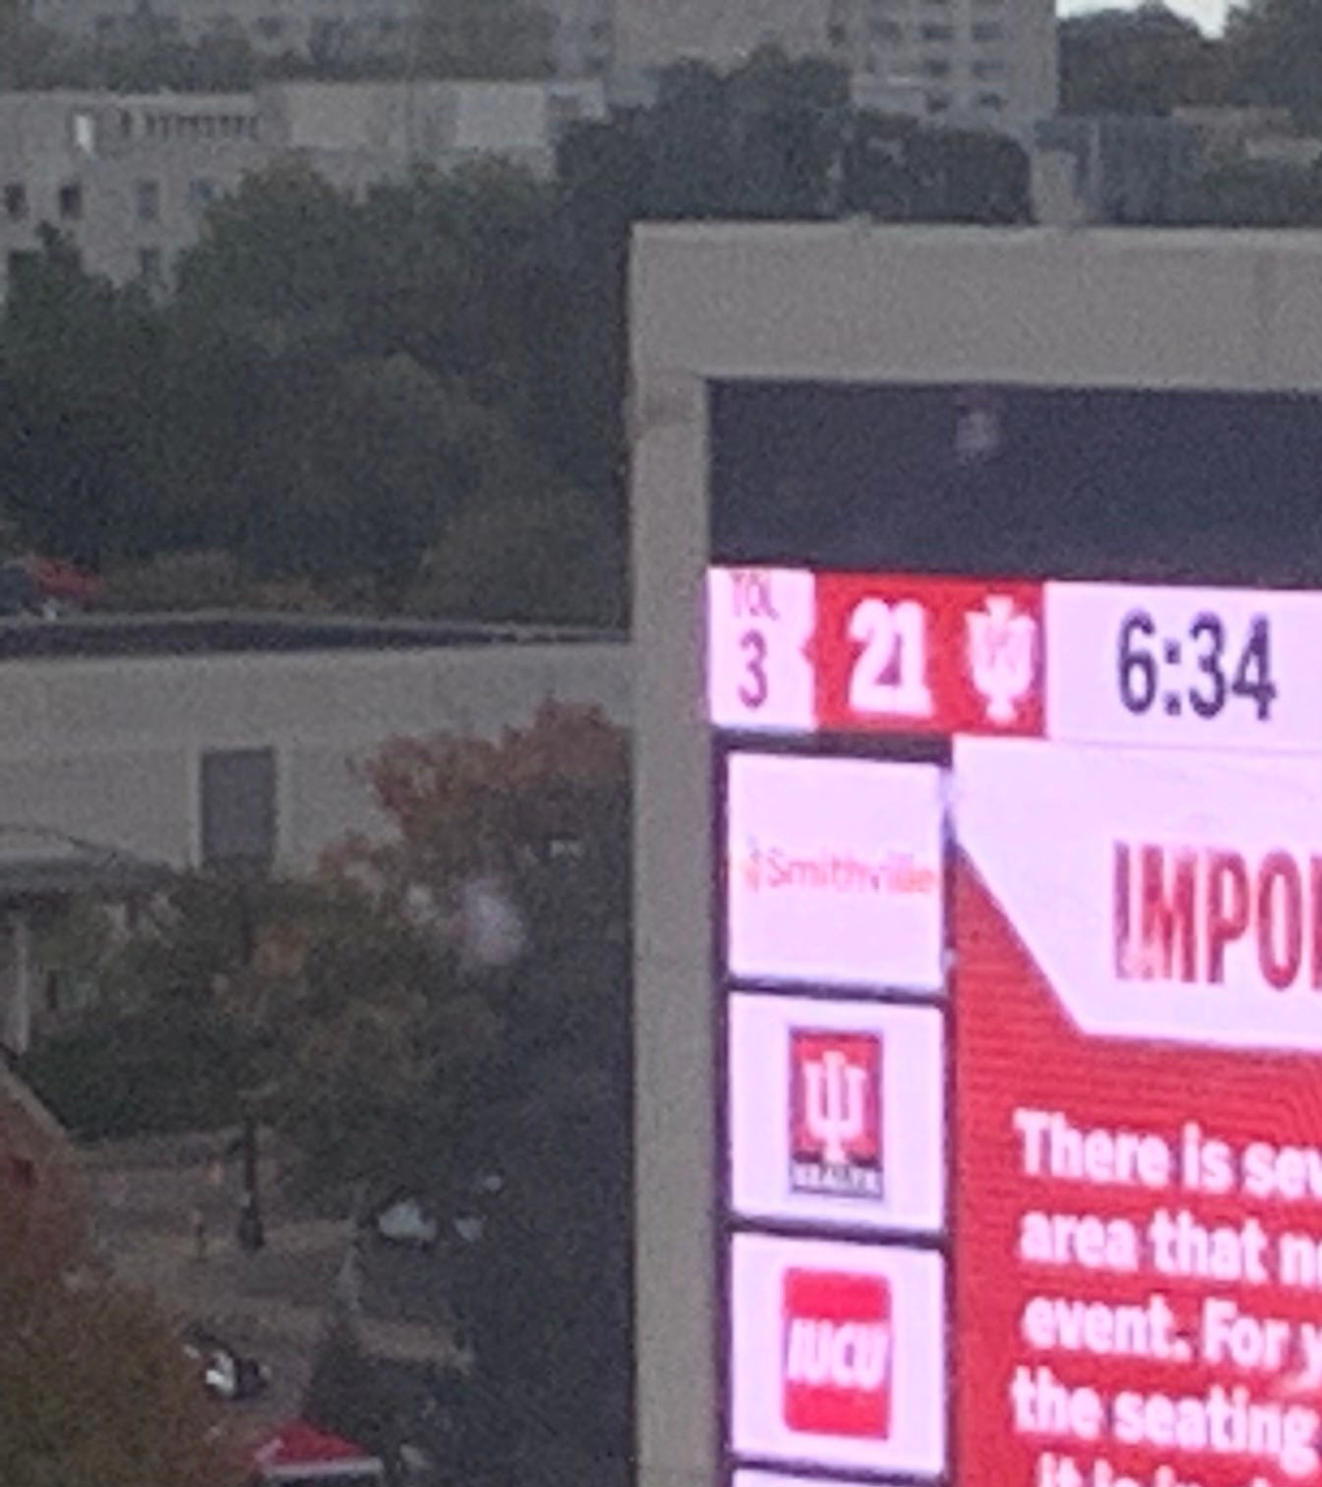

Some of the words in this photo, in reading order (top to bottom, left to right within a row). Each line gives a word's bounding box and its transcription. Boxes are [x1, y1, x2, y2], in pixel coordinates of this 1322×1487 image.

[728, 569, 777, 620] TOL
[740, 630, 768, 706] 3
[849, 600, 933, 717] 21
[1118, 610, 1276, 719] 6:34
[1014, 1108, 1170, 1190] There
[1184, 1122, 1231, 1192] is
[1020, 1209, 1137, 1270] area
[1149, 1209, 1267, 1283] that
[1021, 1294, 1191, 1361] event.
[1202, 1298, 1289, 1370] For
[1010, 1366, 1101, 1439] the
[1113, 1385, 1320, 1477] seating
